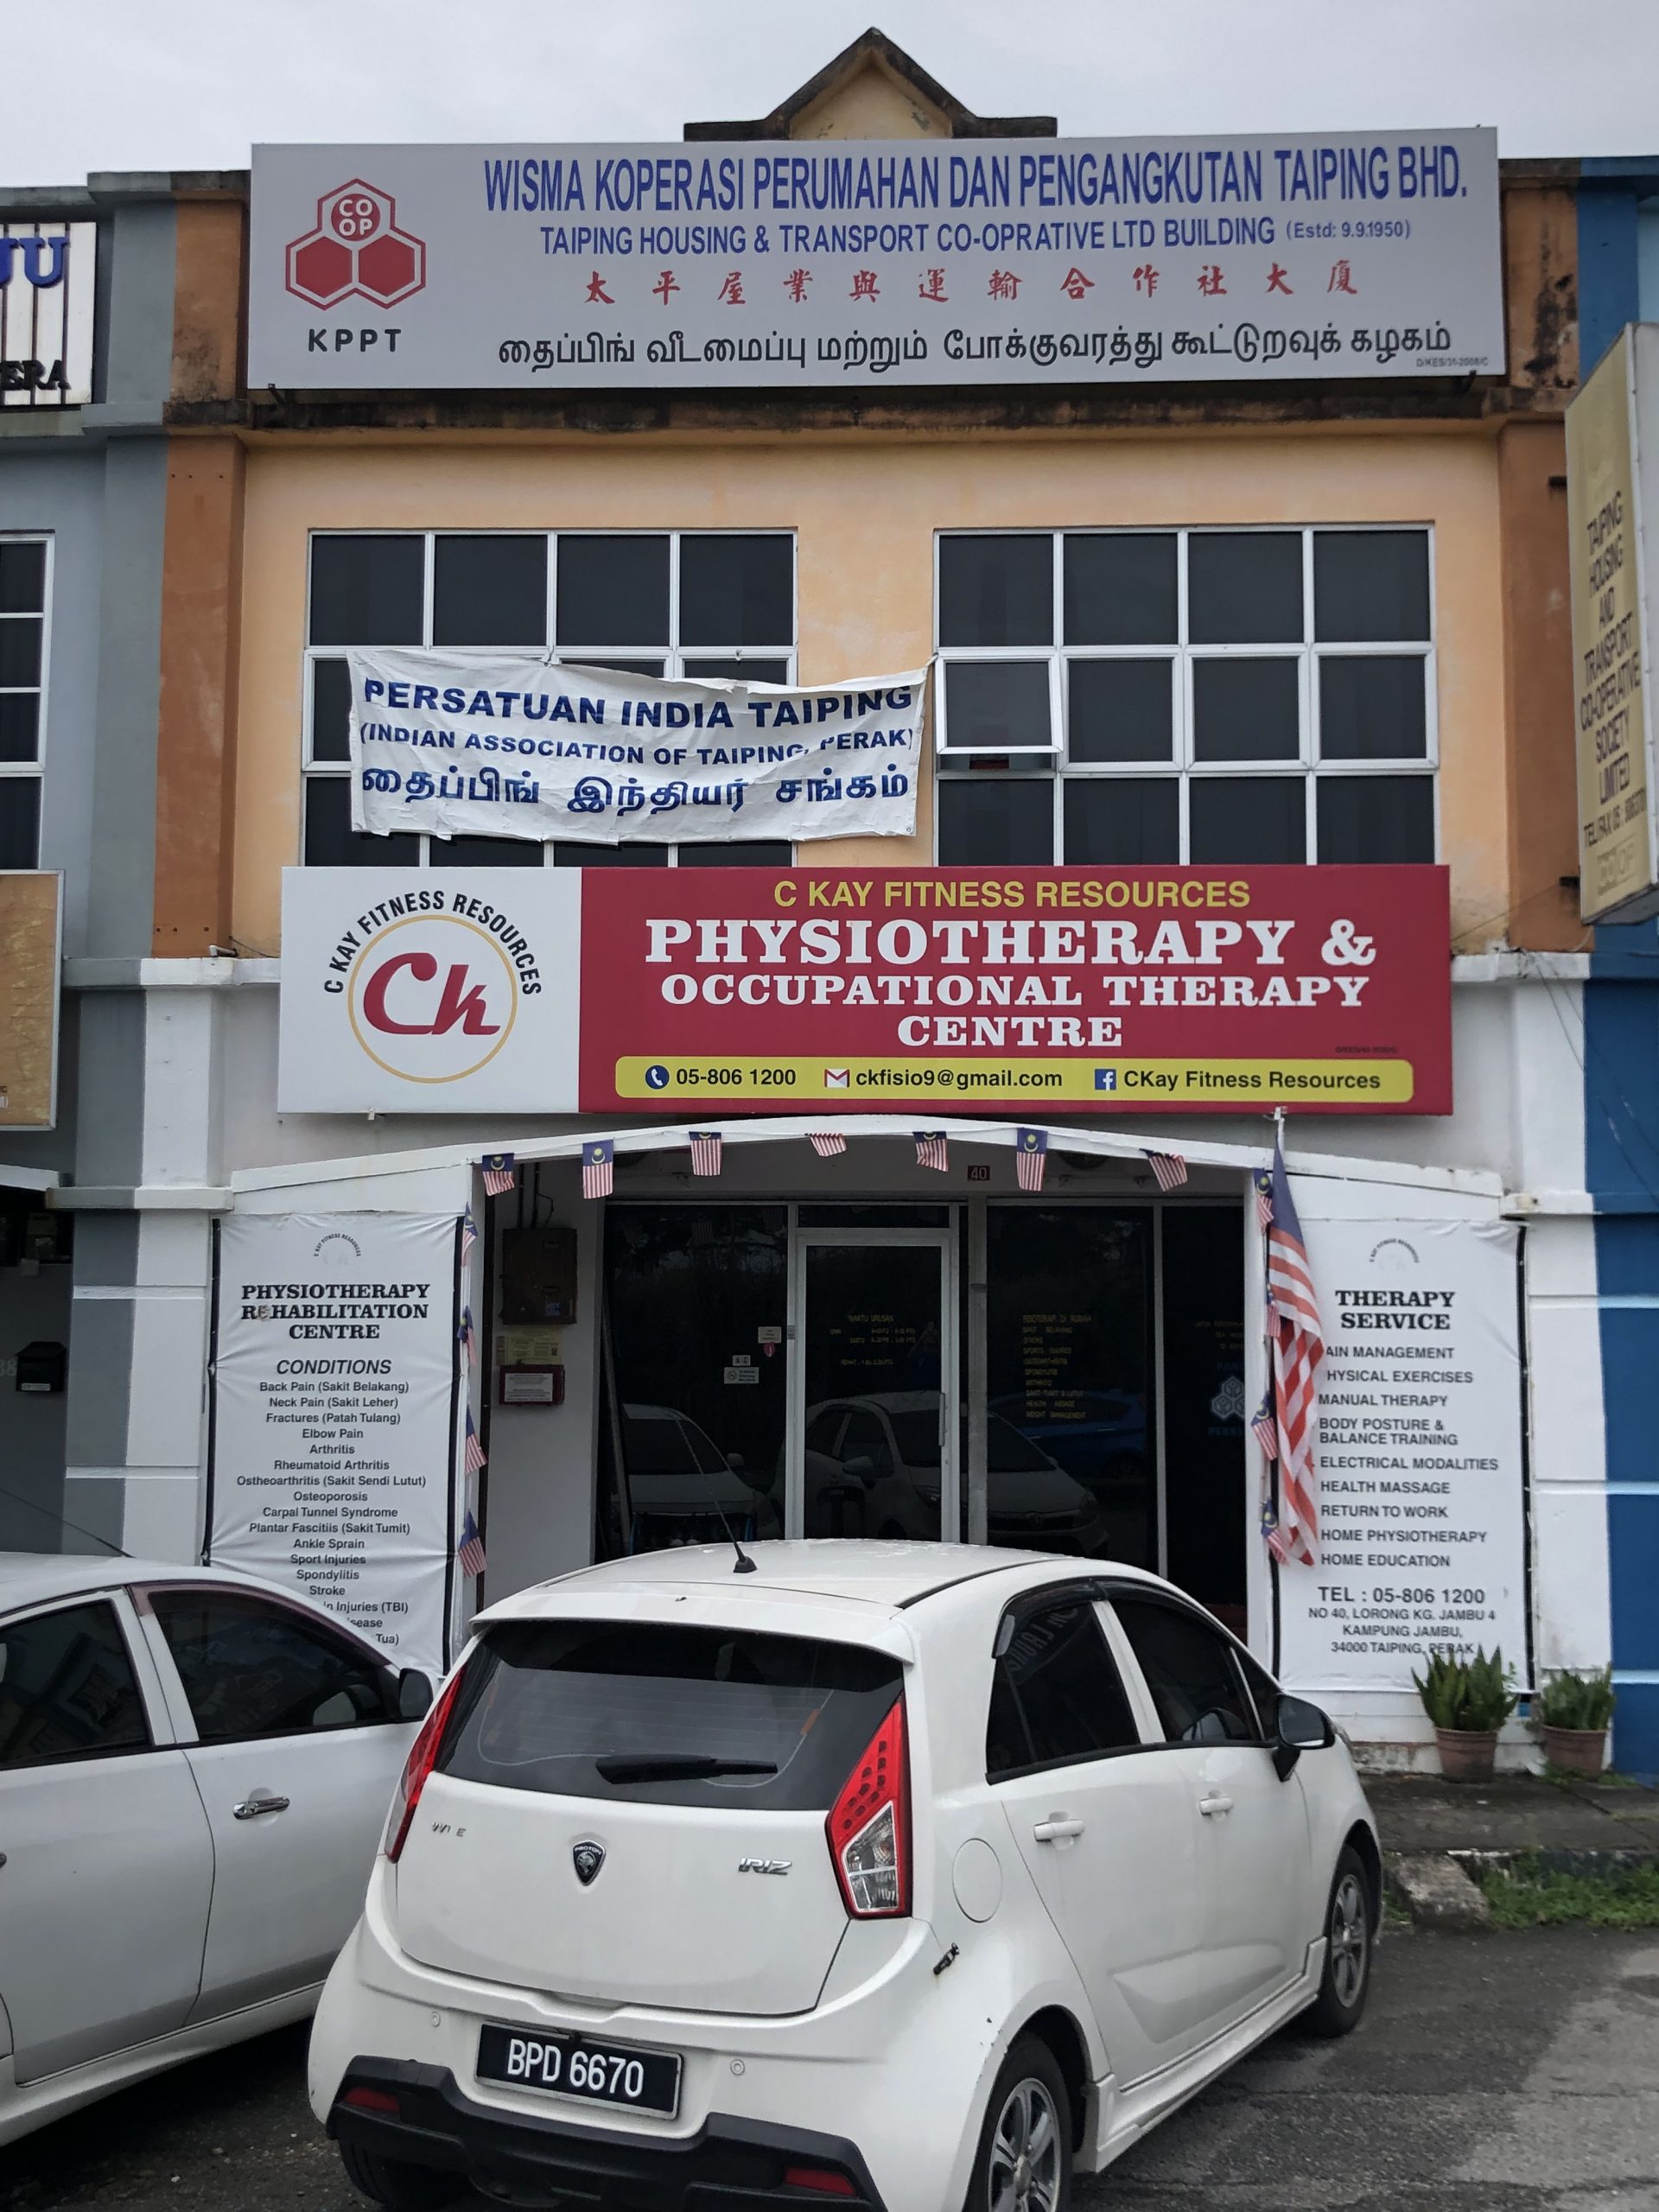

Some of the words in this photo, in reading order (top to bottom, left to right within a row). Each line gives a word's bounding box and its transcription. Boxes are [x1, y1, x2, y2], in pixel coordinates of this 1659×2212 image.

[485, 159, 585, 212] WISMA
[596, 158, 743, 211] KOPERASI
[754, 157, 938, 209] PERUMAHAN
[950, 156, 1009, 207] DAN
[1020, 150, 1262, 207] PENGANGKUTAN
[1274, 147, 1389, 201] TAIPING
[1399, 146, 1466, 198] BHD.
[340, 199, 372, 217] CO
[340, 219, 373, 238] OP
[541, 227, 632, 254] TAIPING
[640, 226, 746, 254] HOUSING
[754, 226, 769, 252] &
[779, 225, 929, 252] TRANSPORT
[938, 222, 1104, 251] CO-OPRATIVE
[1113, 220, 1154, 248] LTD
[1165, 217, 1274, 246] BUILDING
[1287, 221, 1336, 239] (Estd:
[308, 329, 401, 352] KPPT
[499, 332, 634, 372] தைப்பிங்
[647, 331, 805, 368] வீடமைப்பு
[818, 330, 927, 373] மற்றும்
[944, 326, 1161, 368] போக்குவரத்து
[1172, 322, 1341, 363] கூட்டுறவுக்
[1351, 321, 1451, 365] கழகம்
[365, 677, 605, 724] PERSATUAN
[622, 702, 734, 728] INDIA
[748, 686, 911, 728] TAIPING
[1596, 705, 1630, 764] SOCIETY
[360, 722, 454, 747] (INDIAN
[465, 734, 644, 764] ASSOCIATION
[654, 748, 687, 765] OF
[820, 729, 912, 750] PERAK)
[1599, 753, 1630, 804] LIMITED
[363, 766, 539, 804] தைப்பிங்
[568, 777, 748, 817] இந்தியர்
[776, 764, 907, 803] சங்கம்
[775, 881, 796, 906] C
[810, 881, 873, 906] KAY
[886, 881, 1024, 907] FITNESS
[1037, 881, 1249, 907] RESOURCES
[357, 889, 446, 936] FITNESS
[452, 893, 542, 995] RESOURCES
[645, 919, 1294, 964] PHYSIOTHERAPY
[1321, 919, 1376, 965] &
[331, 930, 361, 974] KAY
[324, 981, 343, 993] C
[363, 952, 500, 1035] Ck
[662, 975, 1081, 1005] OCCUPATIONAL
[1103, 976, 1369, 1006] THERAPY
[898, 1016, 1122, 1046] CENTRE
[677, 1069, 741, 1084] 05-806
[750, 1069, 796, 1084] 1200
[856, 1070, 1062, 1090] ckfisio9@gmail.com
[1124, 1071, 1178, 1091] CKay
[1186, 1071, 1261, 1088] Fitness
[1270, 1071, 1380, 1088] Resources
[971, 1166, 987, 1179] 40
[242, 1284, 430, 1300] PHYSIOTHERAPY
[1335, 1291, 1454, 1306] THERAPY
[241, 1304, 429, 1320] REHABILITATION
[1341, 1313, 1450, 1330] SERVICE
[289, 1325, 379, 1339] CENTRE
[1326, 1347, 1348, 1357] AIN
[1353, 1346, 1454, 1358] MANAGEMENT
[277, 1360, 391, 1374] CONDITIONS
[1327, 1371, 1389, 1382] HYSICAL
[1393, 1370, 1473, 1383] EXERCISES
[260, 1382, 287, 1391] Back
[291, 1382, 315, 1391] Pain
[318, 1382, 350, 1393] (Sakit
[353, 1382, 409, 1394] Belakang)
[270, 1398, 296, 1407] Neck
[301, 1397, 324, 1407] Pain
[327, 1397, 359, 1408] (Sakit
[363, 1397, 397, 1408] Leher)
[1319, 1394, 1377, 1405] MANUAL
[1381, 1395, 1447, 1406] THERAPY
[266, 1414, 319, 1422] Fractures
[322, 1413, 357, 1424] (Patah
[359, 1413, 400, 1425] Tulang)
[1319, 1417, 1357, 1429] BODY
[1363, 1419, 1430, 1431] POSTURE
[1434, 1420, 1444, 1431] &
[302, 1429, 336, 1438] Elbow
[340, 1429, 363, 1438] Pain
[1319, 1432, 1387, 1444] BALANCE
[1390, 1433, 1458, 1446] TRAINING
[309, 1445, 354, 1453] Arthritis
[275, 1460, 340, 1470] Rheumatoid
[344, 1460, 390, 1470] Arthritis
[1320, 1456, 1408, 1469] ELECTRICAL
[1413, 1458, 1498, 1471] MODALITIES
[238, 1476, 320, 1485] Ostheoarthritis
[323, 1476, 355, 1487] (Sakit
[359, 1476, 389, 1485] Sendi
[394, 1476, 426, 1487] Lutut)
[1320, 1481, 1376, 1492] HEALTH
[1380, 1482, 1450, 1494] MASSAGE
[294, 1491, 367, 1503] Osteoporosis
[263, 1507, 298, 1519] Carpal
[301, 1507, 337, 1516] Tunnel
[341, 1507, 397, 1519] Syndrome
[1321, 1504, 1378, 1516] RETURN
[1382, 1506, 1401, 1517] TO
[1403, 1506, 1448, 1518] WORK
[250, 1523, 289, 1532] Plantar
[292, 1523, 338, 1533] Fascitiis
[342, 1523, 373, 1535] (Sakit
[376, 1523, 410, 1535] Tumit)
[1321, 1529, 1362, 1541] HOME
[1368, 1529, 1486, 1542] PHYSIOTHERAPY
[294, 1539, 325, 1548] Ankle
[328, 1539, 364, 1550] Sprain
[291, 1554, 321, 1566] Sport
[325, 1554, 365, 1566] Injuries
[1321, 1554, 1363, 1566] HOME
[1368, 1554, 1450, 1567] EDUCATION
[297, 1570, 359, 1581] Spondylitis
[309, 1586, 345, 1595] Stroke
[1318, 1586, 1354, 1601] TEL
[1373, 1588, 1434, 1603] 05-806
[1442, 1589, 1485, 1604] 1200
[337, 1602, 378, 1613] Injuries
[382, 1602, 408, 1614] (TBI)
[1309, 1608, 1328, 1618] NO
[1353, 1608, 1409, 1619] LORONG
[1439, 1610, 1484, 1620] JAMBU
[1488, 1611, 1495, 1619] 4
[1343, 1624, 1410, 1637] KAMPUNG
[1414, 1626, 1462, 1638] JAMBU,
[376, 1633, 399, 1646] Tua)
[1332, 1643, 1368, 1652] 34000
[1371, 1643, 1426, 1654] TAIPING,
[575, 1846, 602, 1855] PROTON
[739, 1857, 792, 1876] IRIZ
[507, 2038, 562, 2082] BPD
[569, 2054, 645, 2098] 6670
